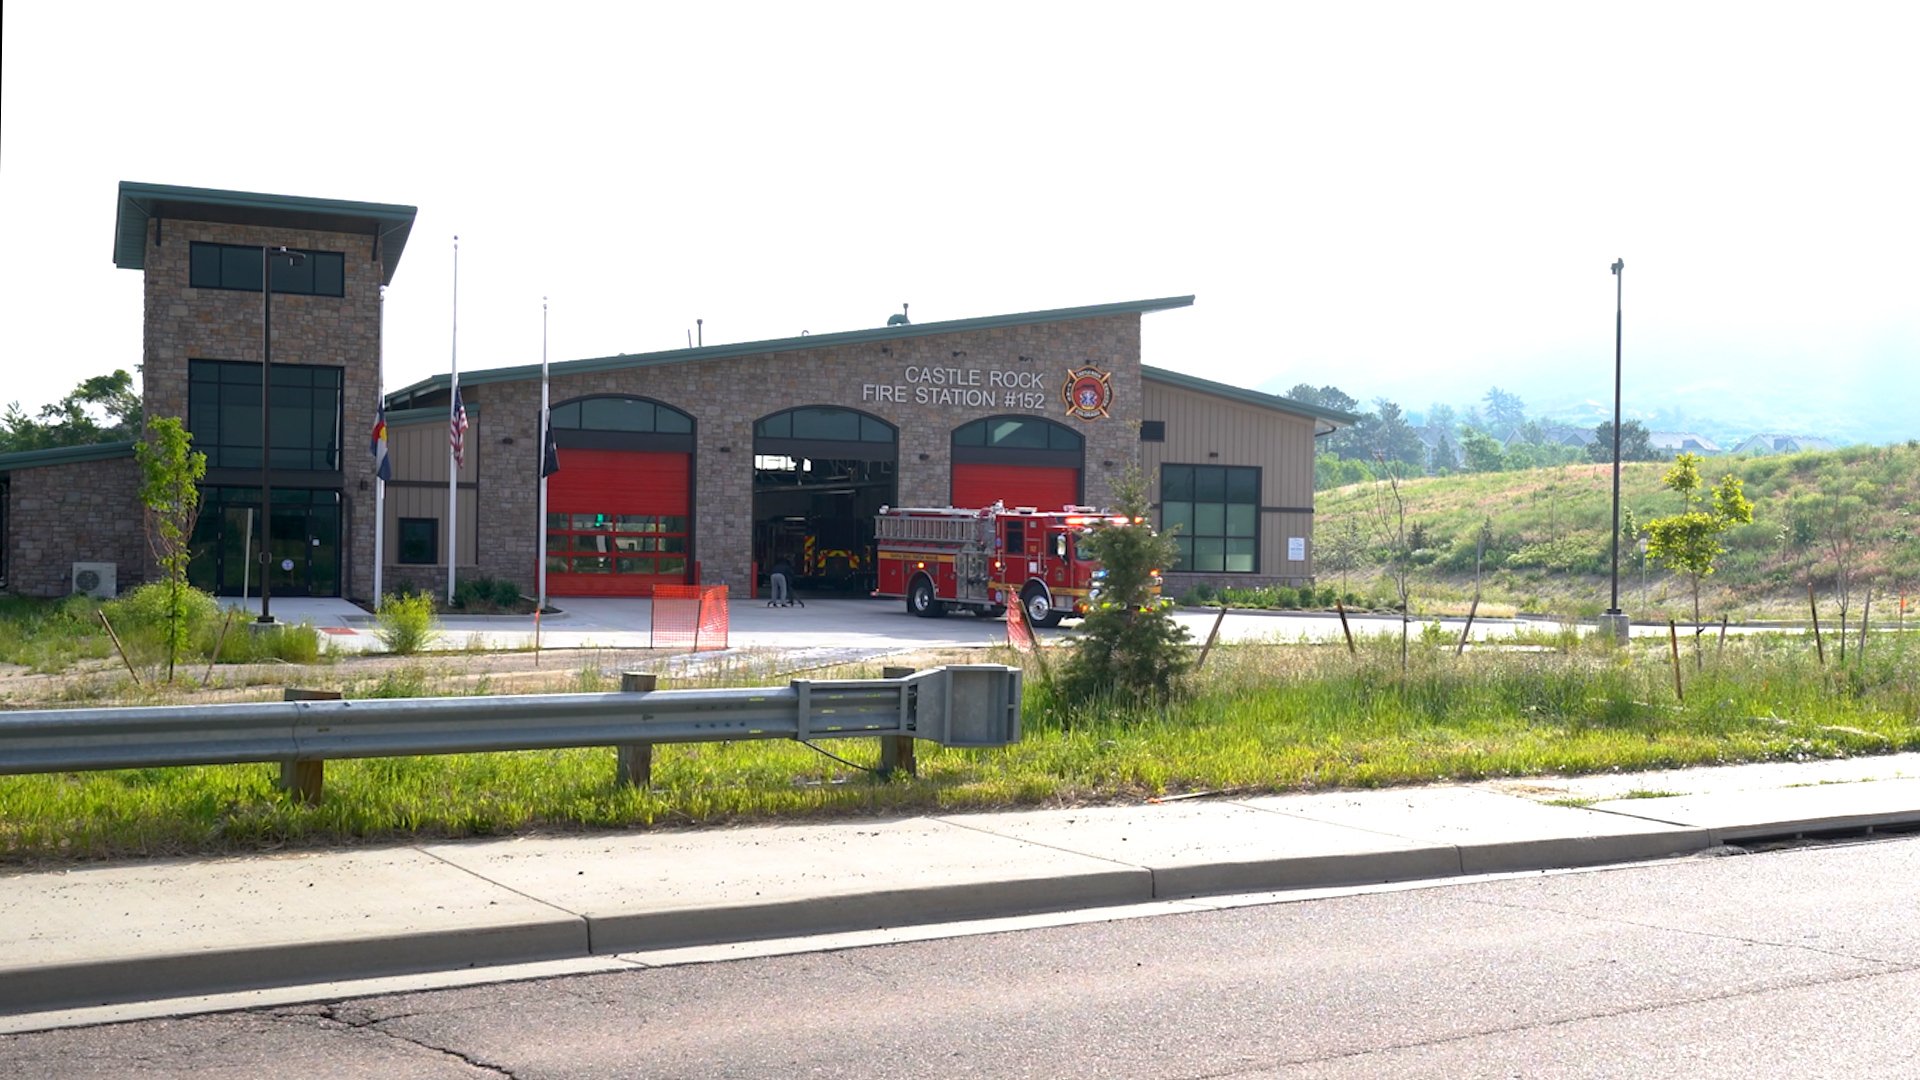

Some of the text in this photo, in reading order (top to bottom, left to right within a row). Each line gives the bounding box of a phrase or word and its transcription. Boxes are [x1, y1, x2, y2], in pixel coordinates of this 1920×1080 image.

[905, 366, 1044, 389] CASTLE ROCK
[862, 383, 907, 403] FIRE
[915, 386, 996, 407] STATION
[1004, 391, 1045, 409] #152
